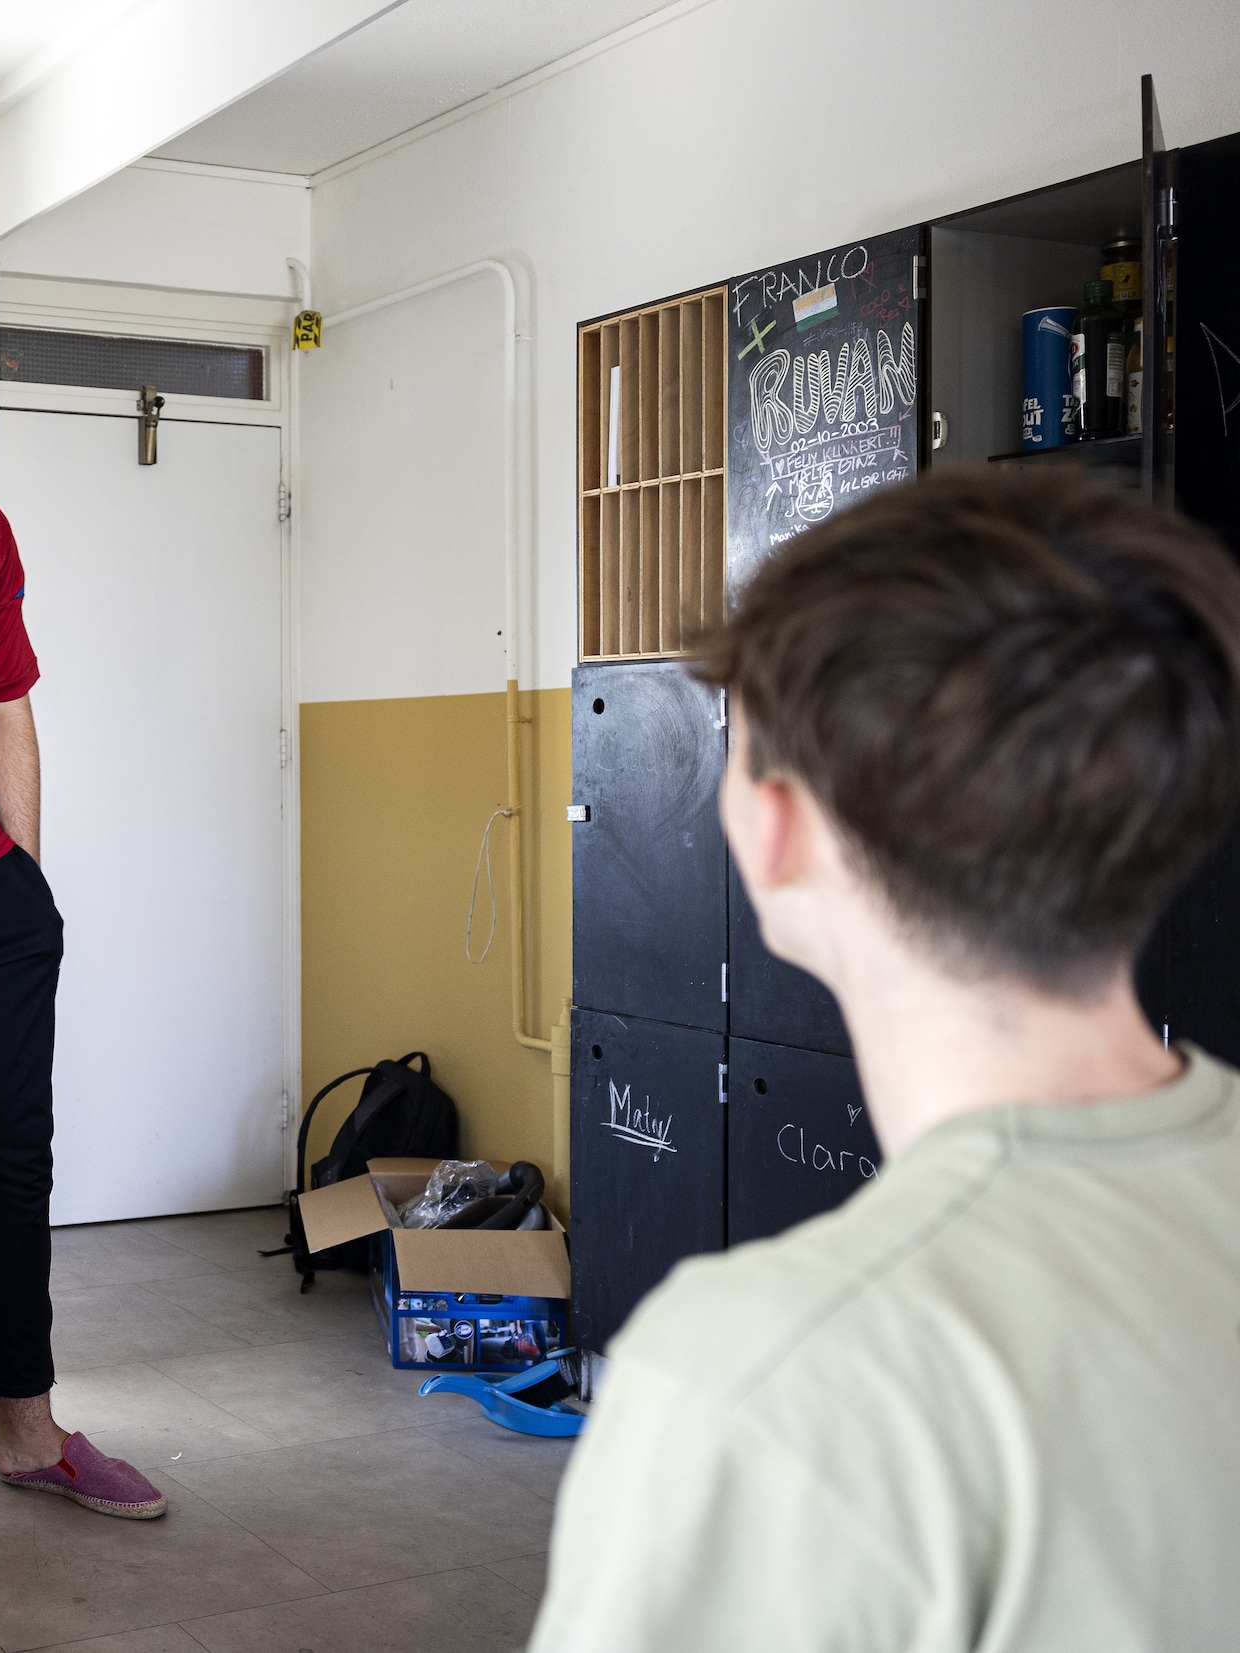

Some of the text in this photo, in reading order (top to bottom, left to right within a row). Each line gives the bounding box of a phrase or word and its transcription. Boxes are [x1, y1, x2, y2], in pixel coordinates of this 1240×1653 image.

[732, 246, 868, 328] FRANCO
[791, 418, 879, 453] 02-10-2003
[787, 451, 818, 475] FELIX
[777, 1123, 879, 1182] Clara
